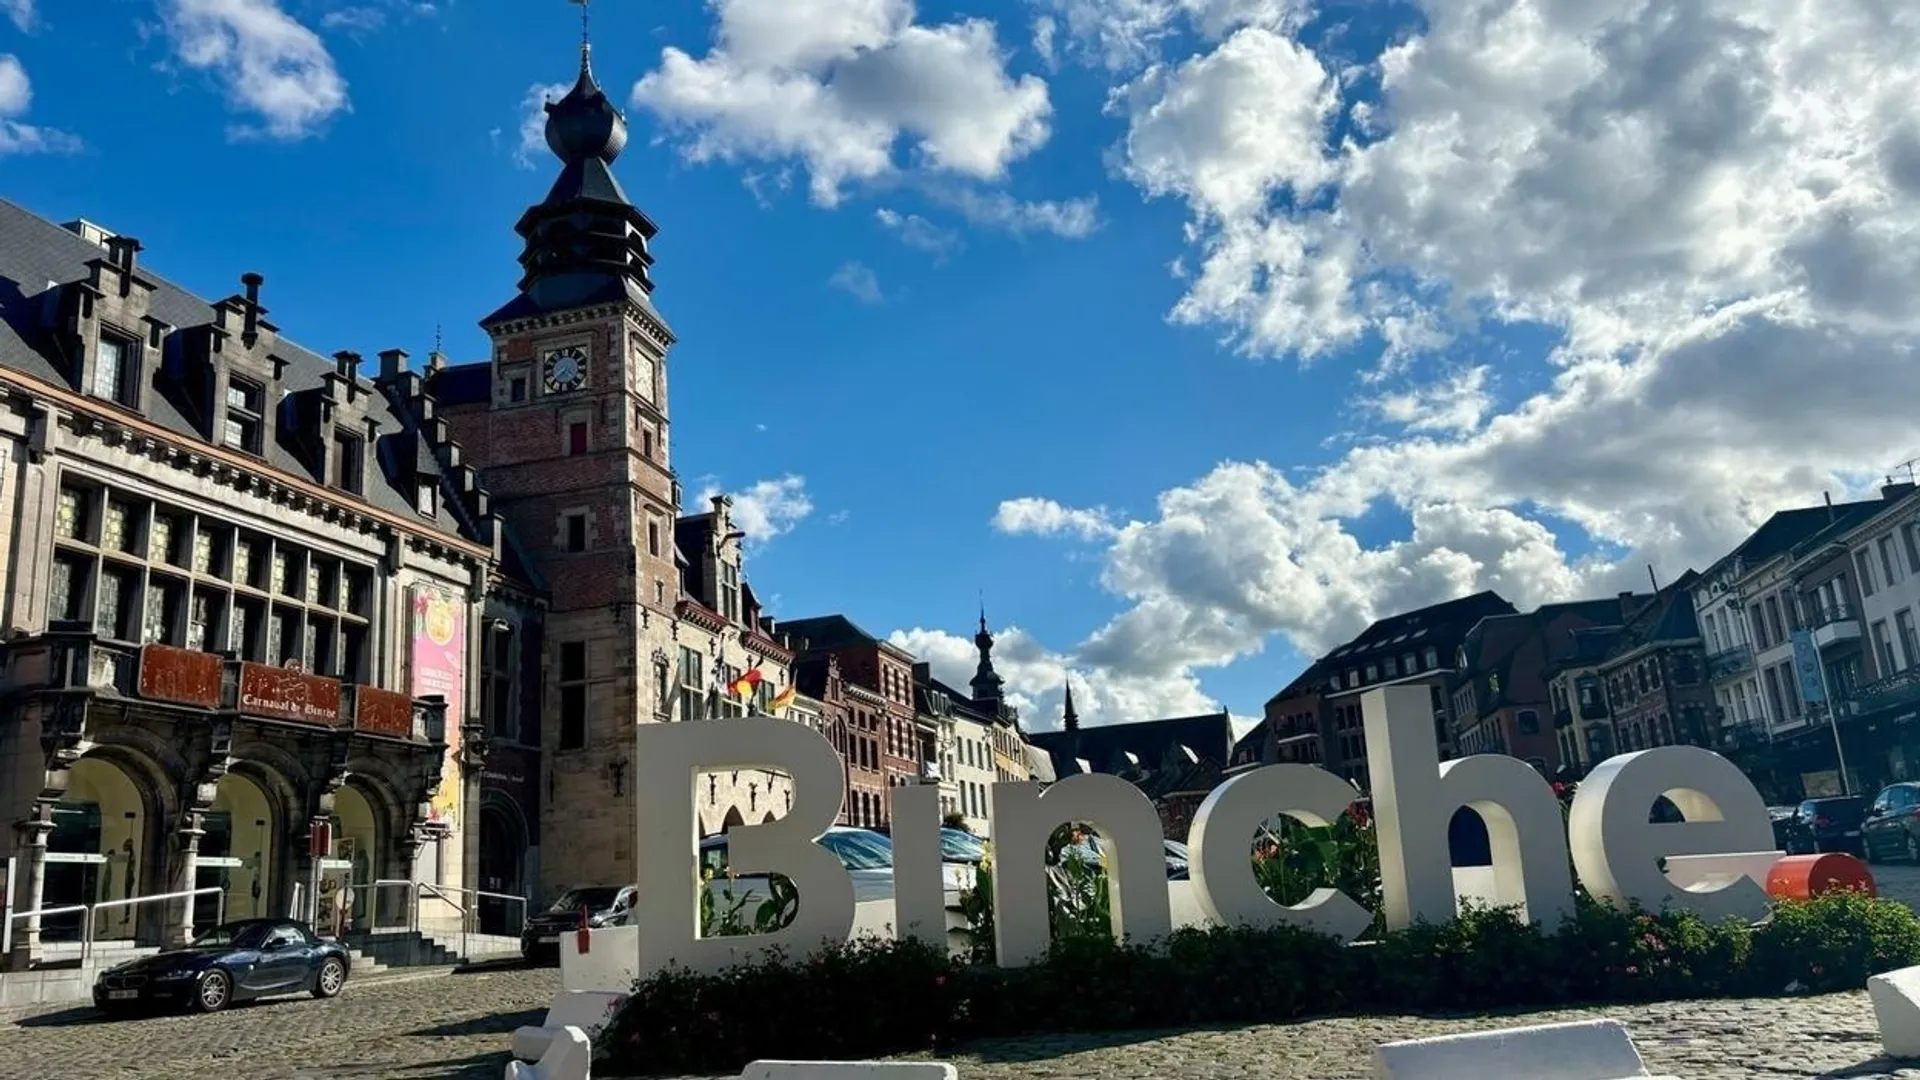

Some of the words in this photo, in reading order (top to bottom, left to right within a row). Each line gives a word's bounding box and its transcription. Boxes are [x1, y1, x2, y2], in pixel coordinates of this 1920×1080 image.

[242, 693, 289, 711] Carnaval
[304, 703, 337, 718] Binche
[636, 685, 1774, 980] Binche
